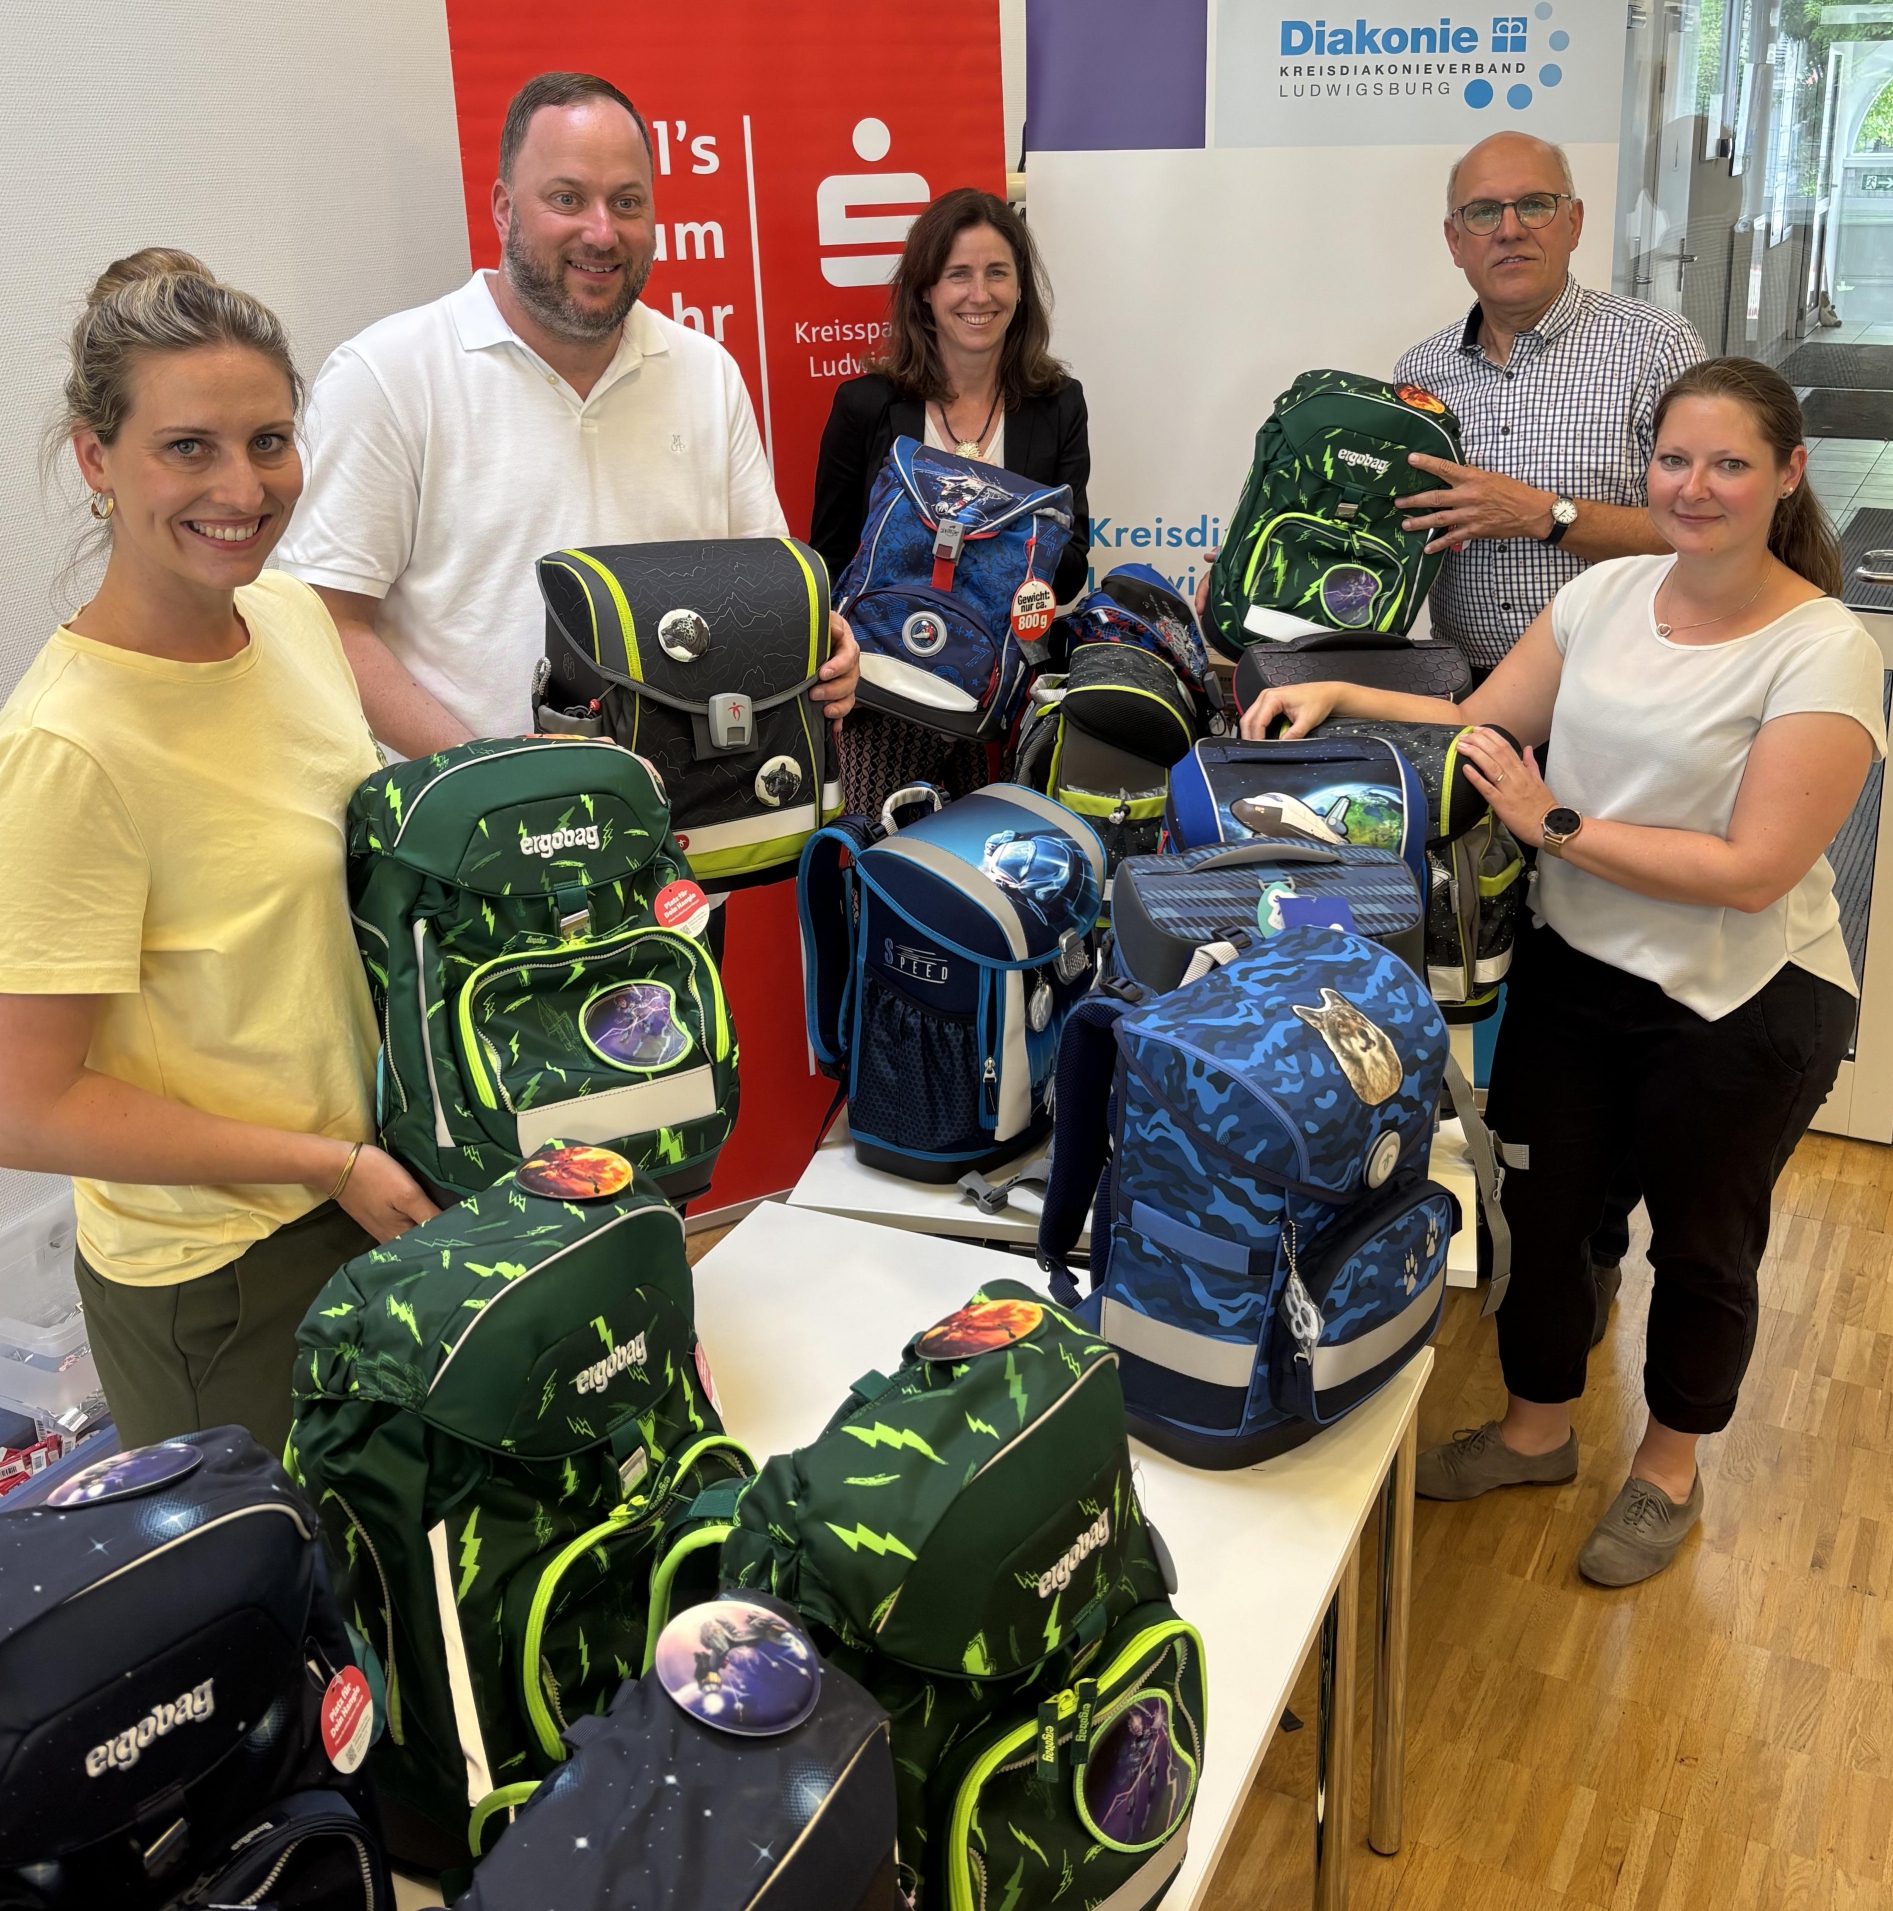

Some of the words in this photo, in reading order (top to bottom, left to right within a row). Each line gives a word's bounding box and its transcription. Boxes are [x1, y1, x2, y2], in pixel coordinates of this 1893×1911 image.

[1280, 18, 1479, 56] Diakonie
[1280, 63, 1526, 77] KREISDIAKONIEVERBAND
[1279, 81, 1451, 98] LUDWIGSBURG
[652, 120, 721, 176] l's
[671, 291, 734, 342] hr
[795, 319, 893, 345] Kreisspa
[1337, 448, 1389, 475] ergobag
[1089, 514, 1229, 548] Kreisdi
[1017, 590, 1050, 606] Gewicht:
[1020, 603, 1034, 613] nur
[1035, 601, 1047, 610] ca.
[520, 825, 600, 858] ergobag
[884, 937, 949, 981] SPEED
[576, 1330, 648, 1395] ergobag
[1038, 1506, 1110, 1599] ergobag
[85, 1677, 215, 1778] ergobag
[1042, 1725, 1055, 1763] ergobag
